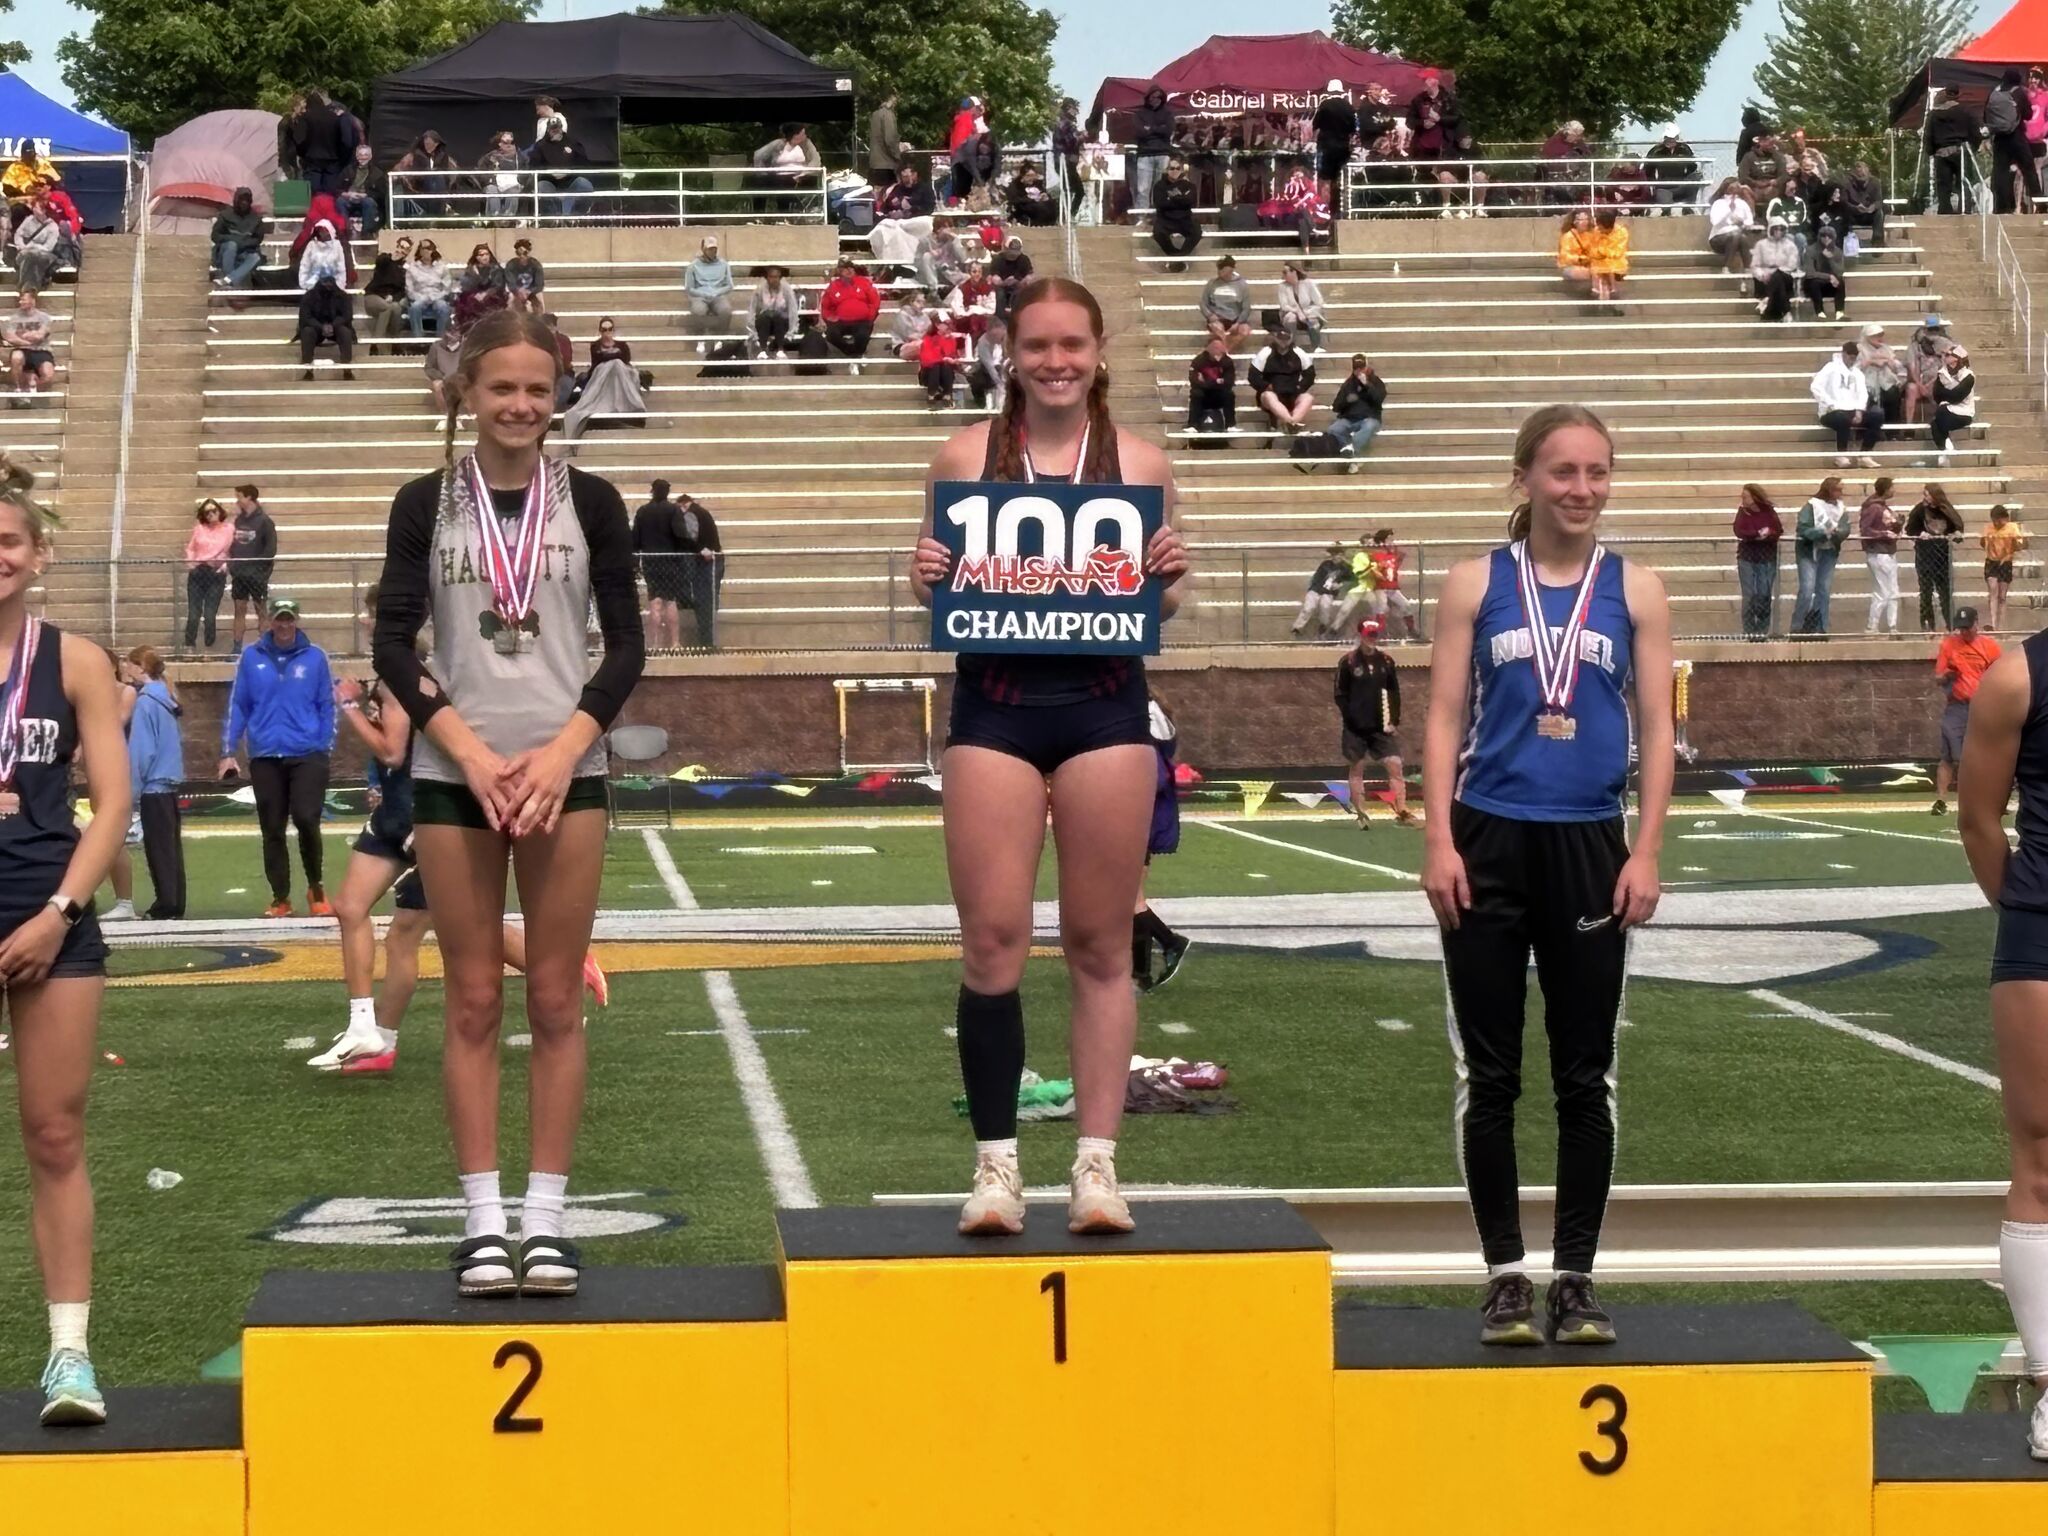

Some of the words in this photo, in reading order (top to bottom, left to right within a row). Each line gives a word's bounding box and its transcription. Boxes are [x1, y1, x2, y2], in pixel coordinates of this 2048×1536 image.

[1189, 89, 1265, 109] Gabriel
[1273, 89, 1352, 110] Richd
[946, 495, 1144, 573] 100
[951, 553, 1118, 595] MHSAA
[946, 609, 1146, 642] CHAMPION
[1040, 1270, 1067, 1365] 1
[493, 1340, 543, 1433] 2
[1578, 1383, 1628, 1476] 3
